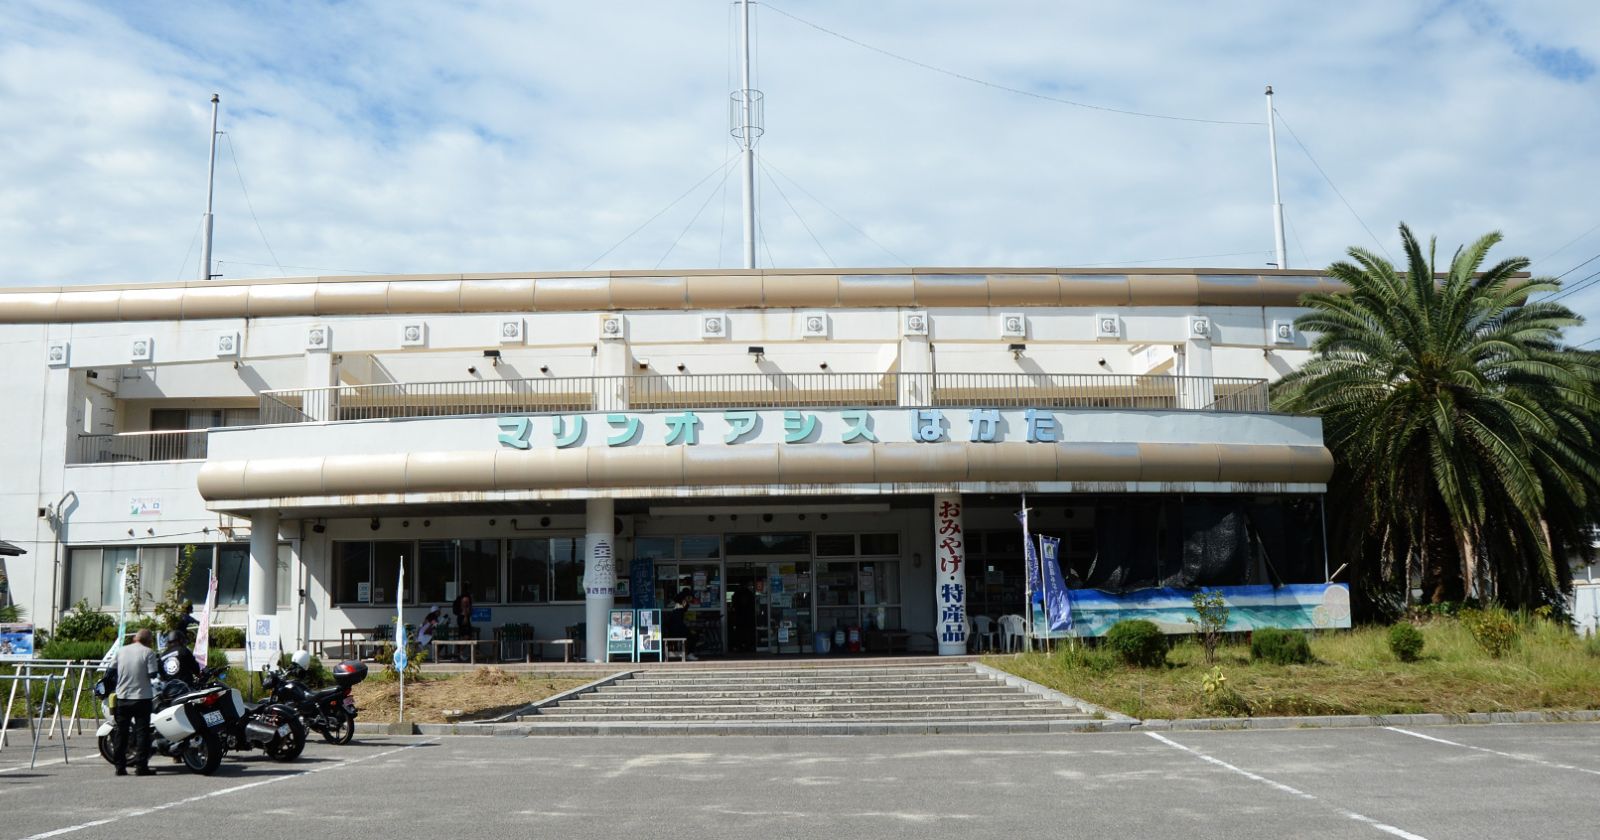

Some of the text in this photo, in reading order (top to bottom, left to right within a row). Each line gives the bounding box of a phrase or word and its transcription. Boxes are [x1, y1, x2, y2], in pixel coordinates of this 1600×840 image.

[497, 409, 1057, 449] マリンオアシス はかた
[939, 501, 965, 642] おみやげ・特産品
